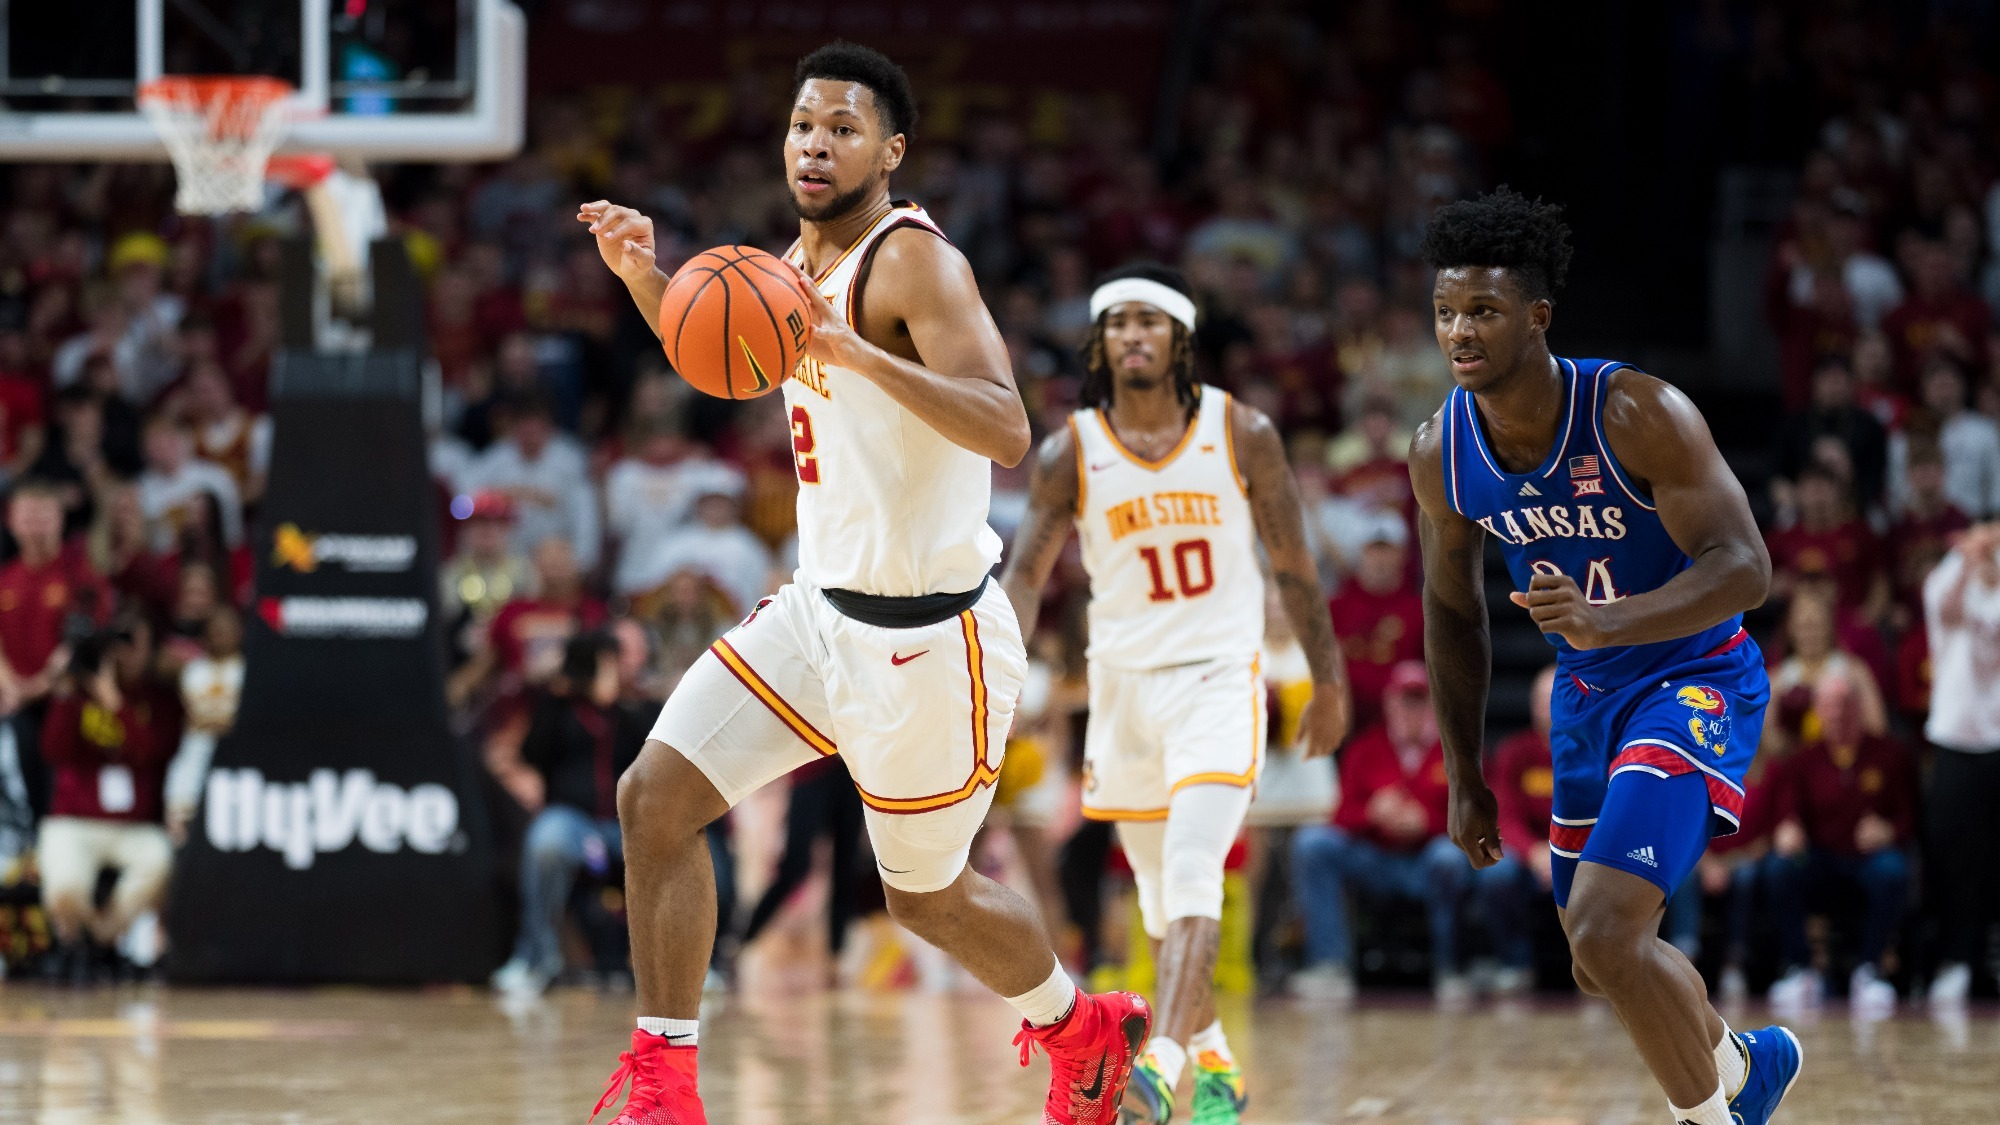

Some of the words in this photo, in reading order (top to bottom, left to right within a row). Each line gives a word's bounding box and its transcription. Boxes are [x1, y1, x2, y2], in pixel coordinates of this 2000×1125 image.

[791, 403, 821, 485] 2
[1153, 491, 1223, 526] STATE
[1476, 505, 1627, 545] KANSAS
[1138, 537, 1215, 602] 10
[1709, 720, 1723, 735] KU
[1627, 850, 1658, 868] adidas
